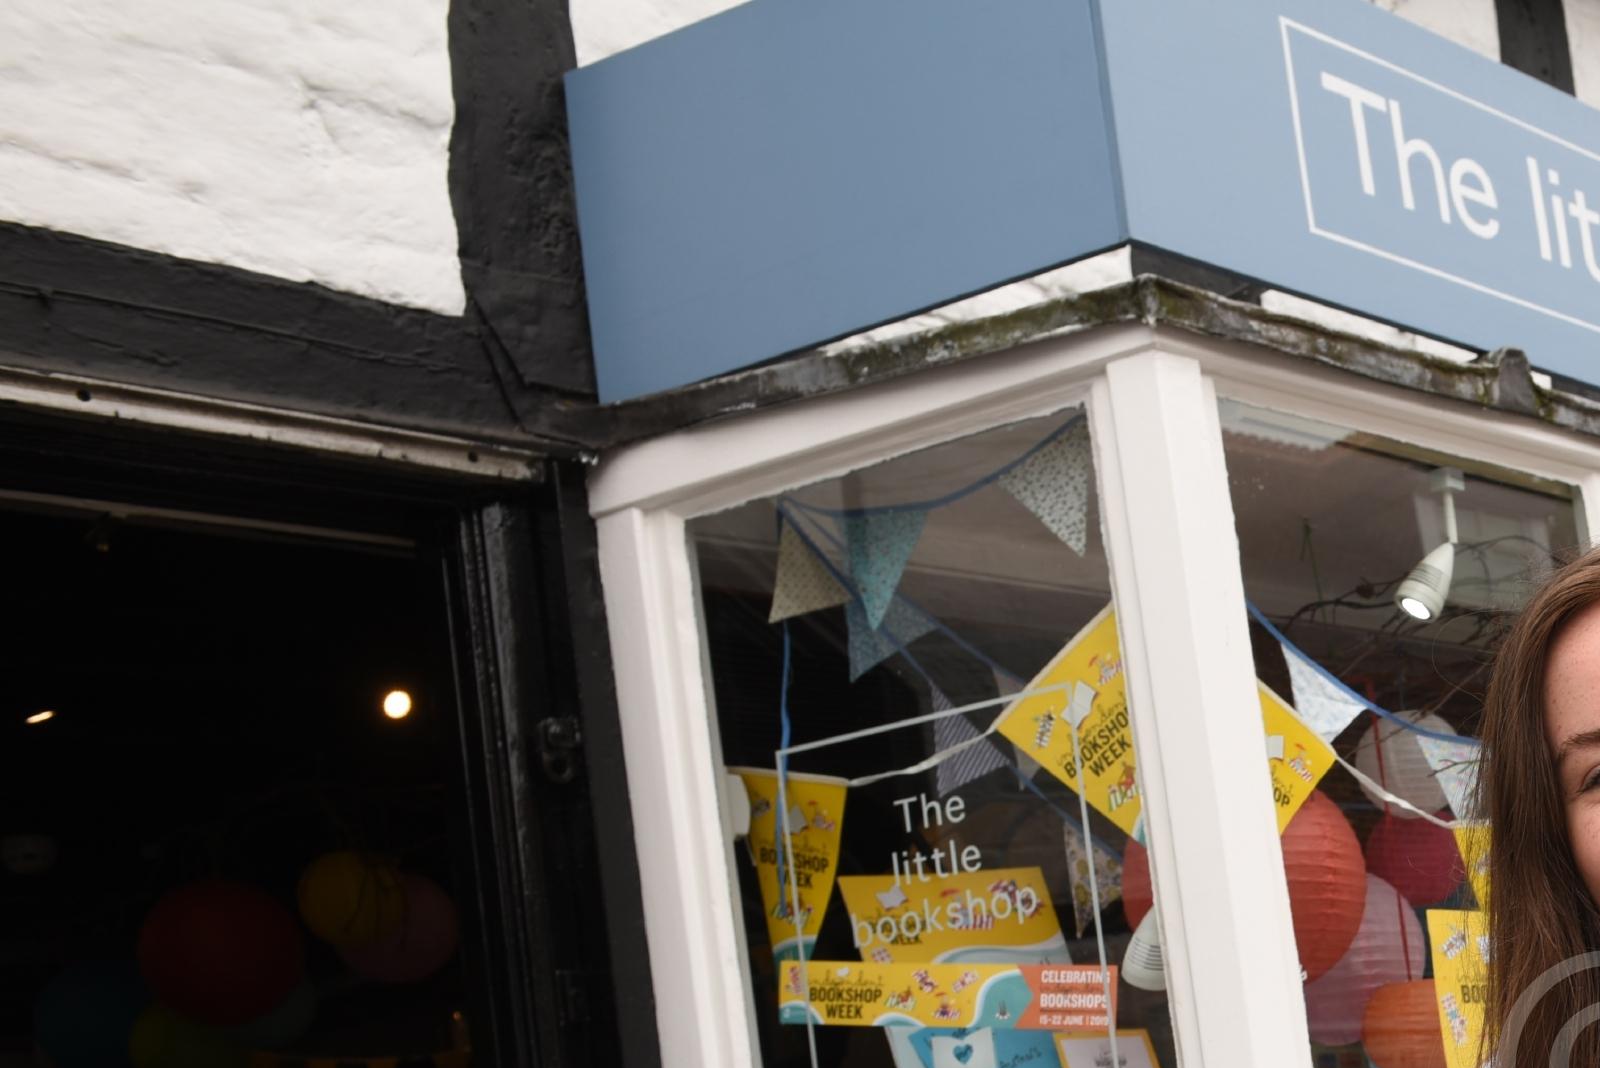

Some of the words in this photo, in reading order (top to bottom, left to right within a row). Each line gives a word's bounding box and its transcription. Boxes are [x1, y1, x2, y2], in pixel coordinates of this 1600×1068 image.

[1321, 72, 1499, 240] The
[1063, 706, 1129, 779] BOOKSHO
[1088, 734, 1131, 777] WEEK
[893, 792, 967, 834] The
[891, 840, 983, 888] little
[850, 885, 1038, 949] bookshop
[809, 987, 883, 1003] BOOKSHOP
[825, 1003, 863, 1019] WEEK
